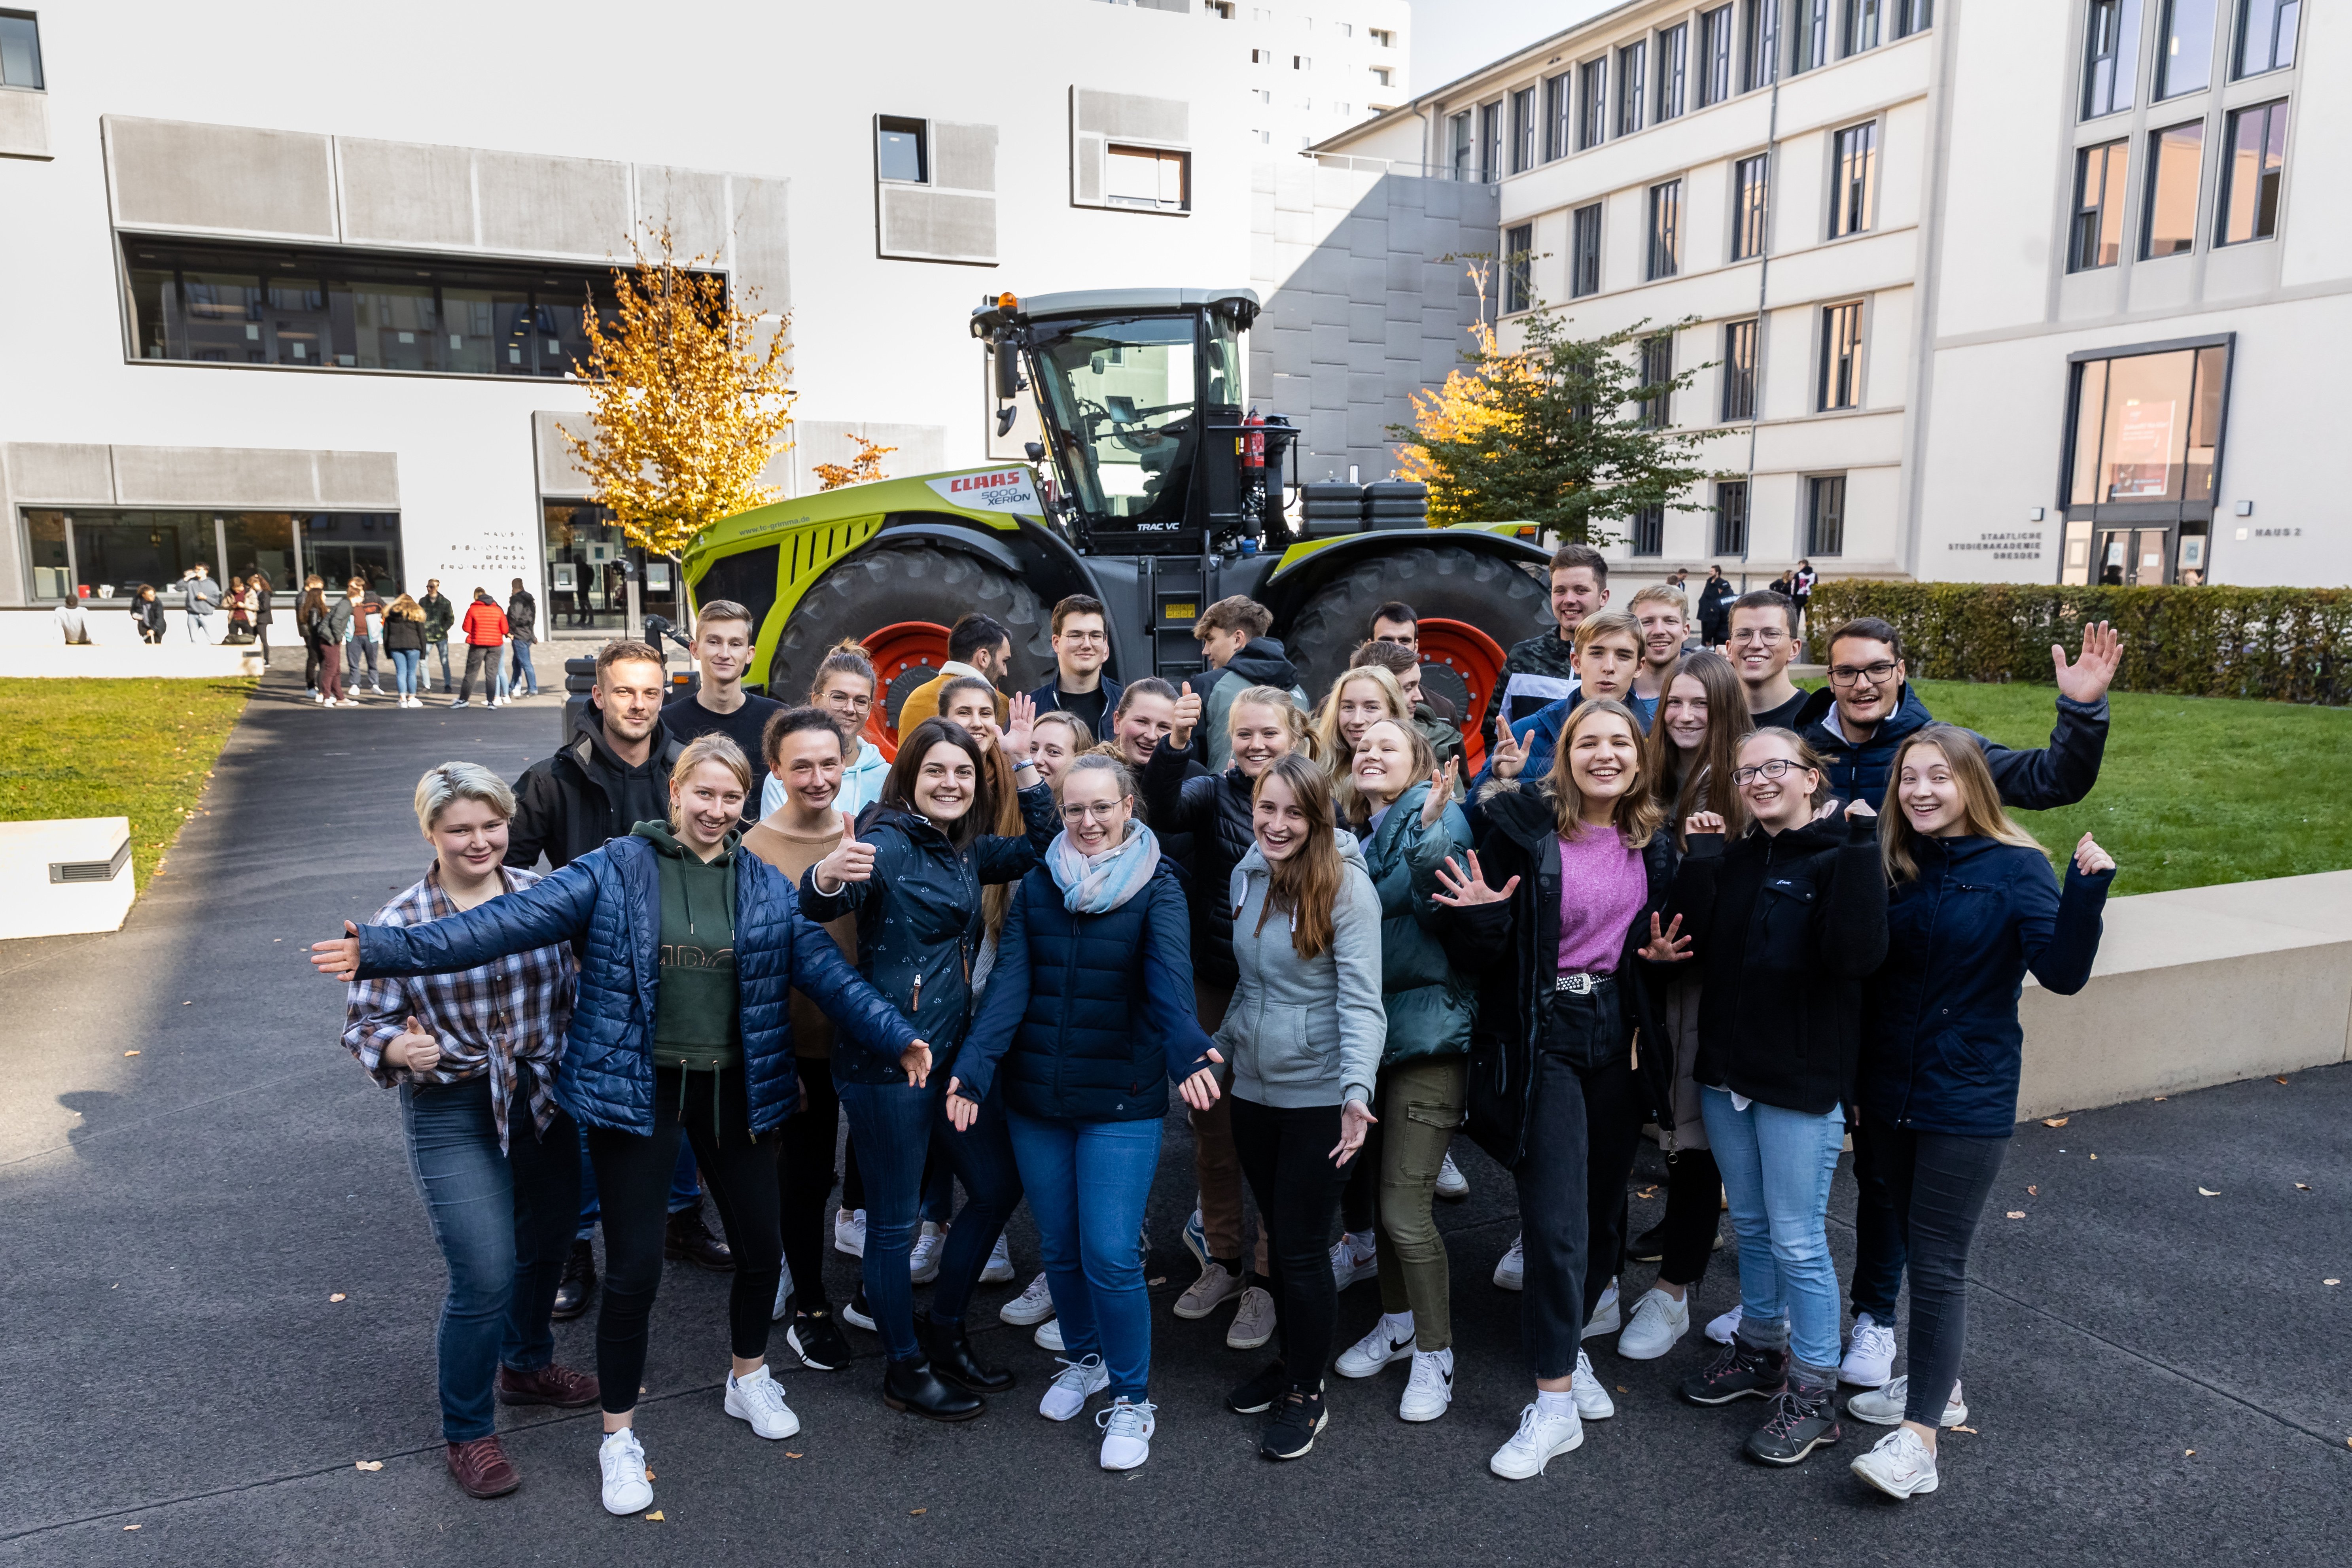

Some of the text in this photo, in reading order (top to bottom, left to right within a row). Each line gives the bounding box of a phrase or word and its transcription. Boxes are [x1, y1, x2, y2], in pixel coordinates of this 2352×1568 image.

[951, 471, 1020, 492] CLAAS
[981, 488, 1017, 499] 5000
[988, 493, 1031, 506] XERION
[739, 516, 810, 535] www.tc-grimma.de
[2255, 528, 2302, 537] HAUS 2
